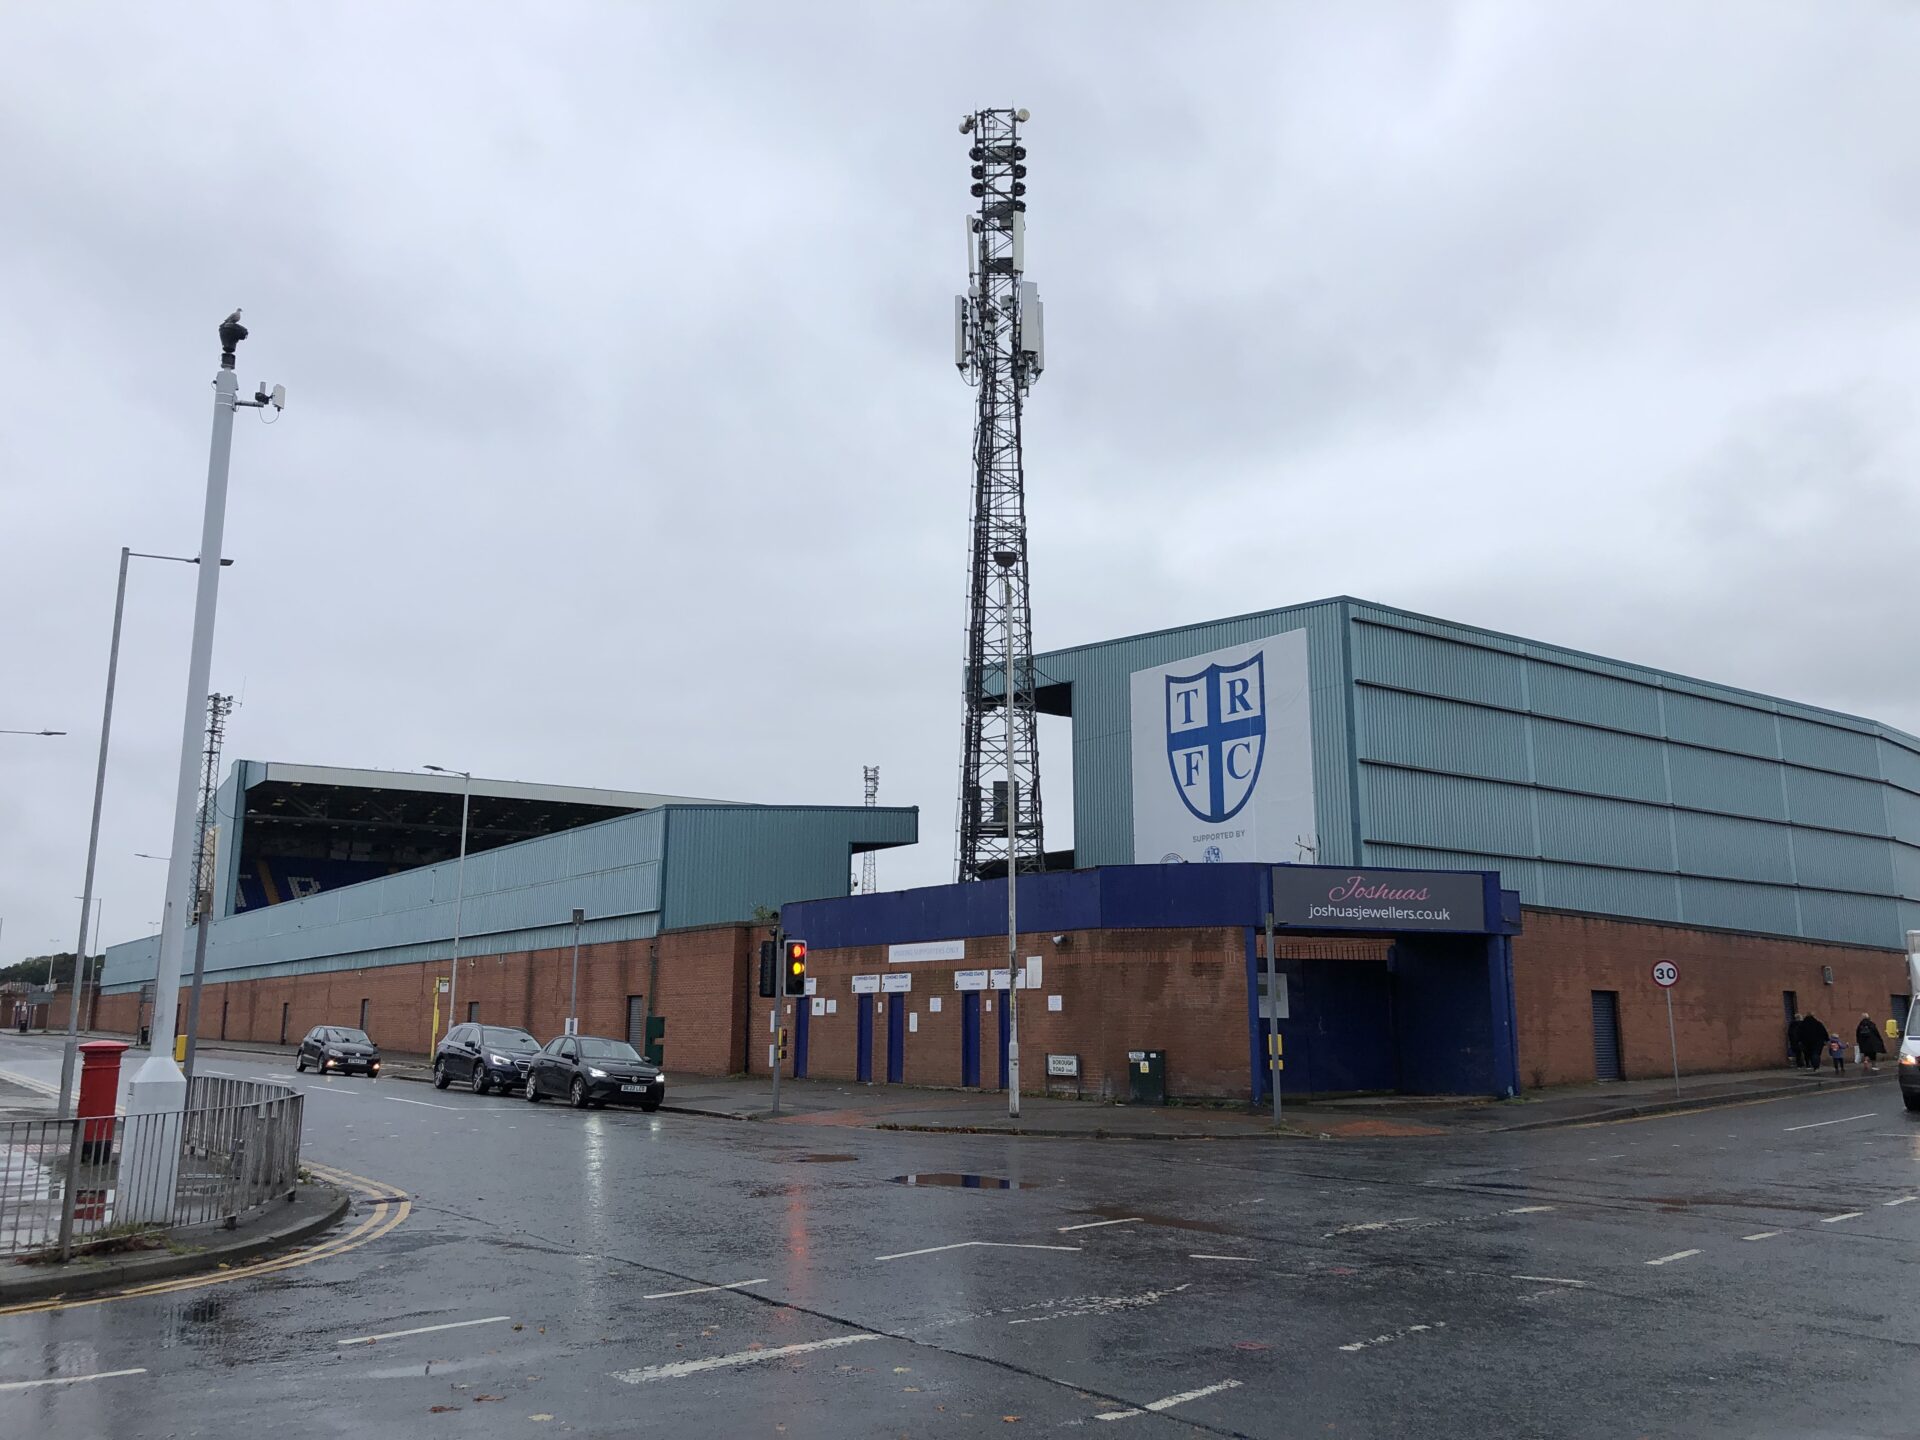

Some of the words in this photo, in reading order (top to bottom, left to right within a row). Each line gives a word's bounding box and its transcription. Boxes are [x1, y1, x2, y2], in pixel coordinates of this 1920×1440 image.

[1176, 688, 1199, 724] T
[1226, 678, 1253, 715] R
[1183, 750, 1203, 787] F
[1226, 742, 1251, 780] C
[1192, 831, 1234, 843] SUPPORTED
[1235, 829, 1245, 838] BY
[1328, 875, 1431, 902] Joshuas
[1308, 904, 1450, 920] joshuasjewellers.co.uk
[1656, 967, 1676, 980] 30
